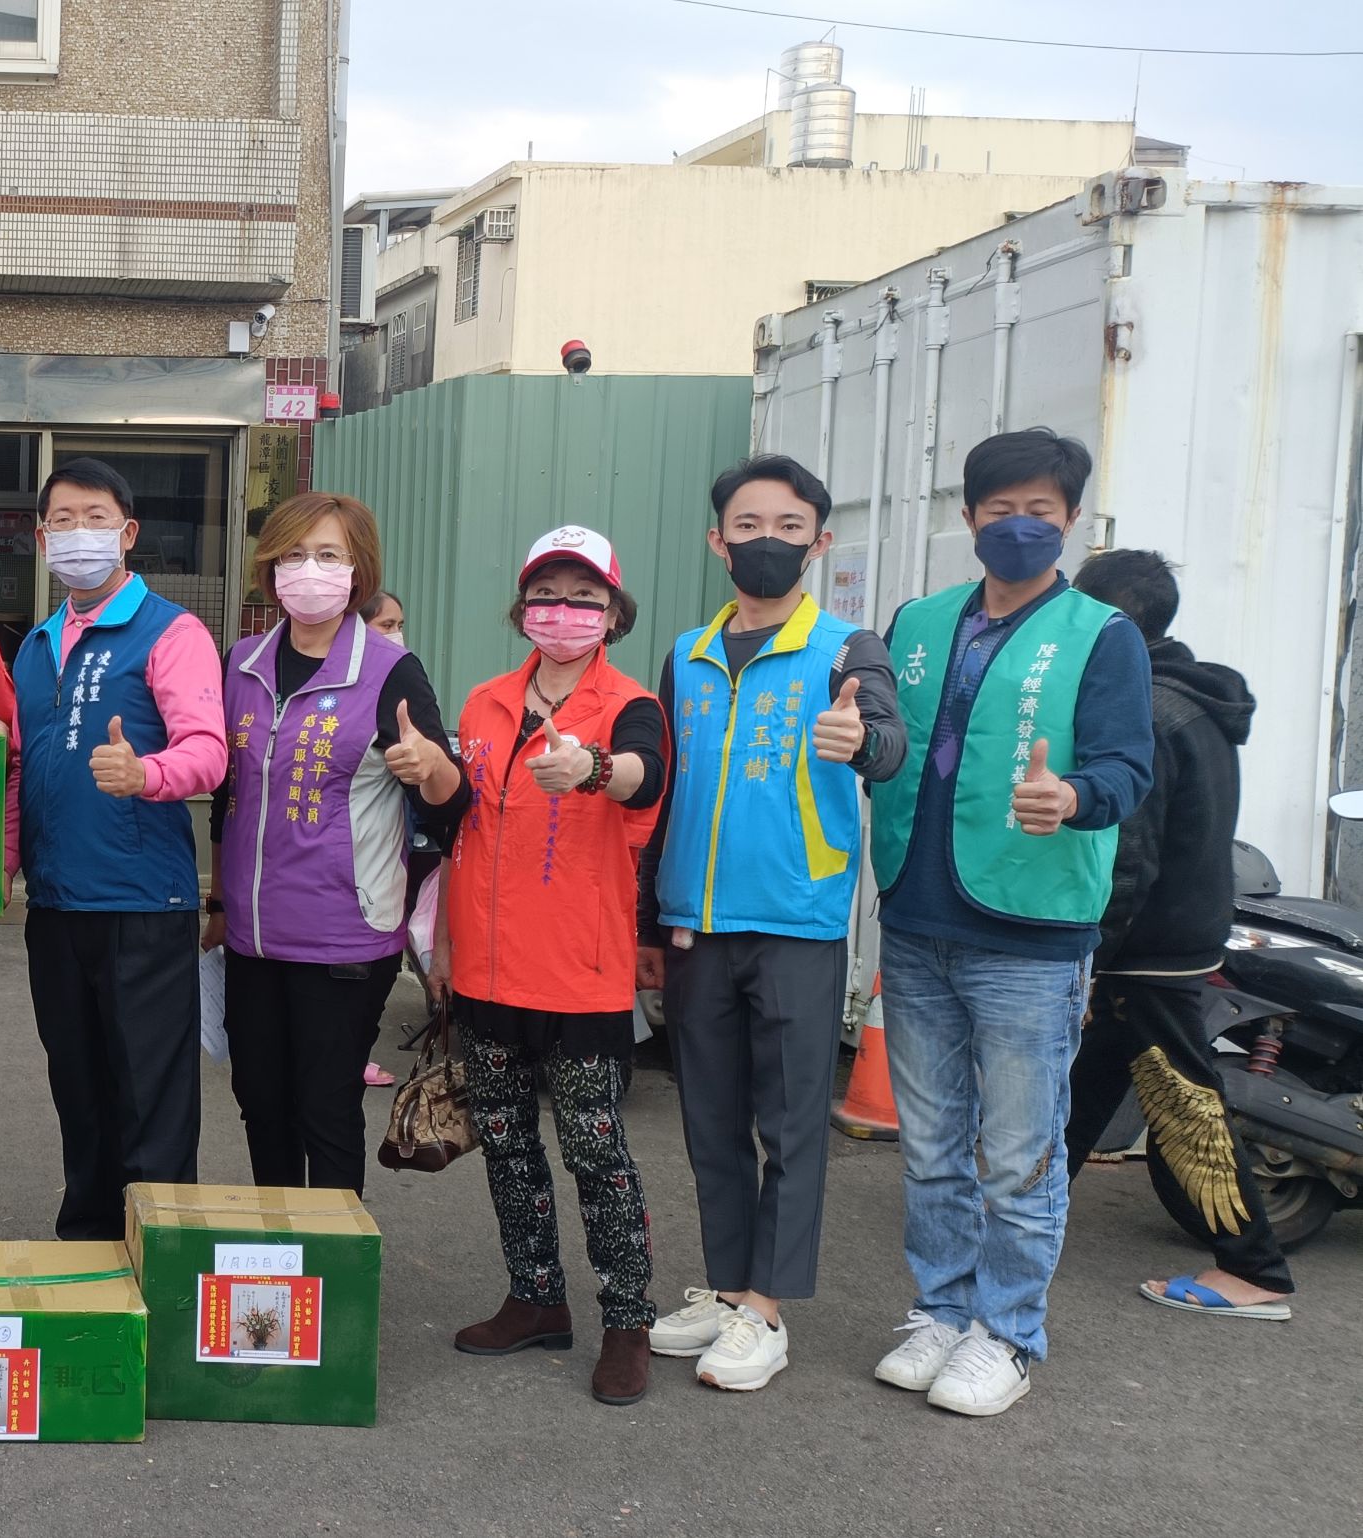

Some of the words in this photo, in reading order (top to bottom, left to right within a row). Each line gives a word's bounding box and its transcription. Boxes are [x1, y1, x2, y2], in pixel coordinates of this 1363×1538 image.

[281, 400, 306, 417] 42
[259, 433, 272, 474] 龍潭區
[276, 434, 288, 472] 桃園市
[89, 650, 112, 702] 凌雲里
[898, 643, 927, 686] 志
[236, 713, 254, 748] 助理
[780, 680, 804, 768] 桃園市議員
[286, 713, 318, 821] 感恩服務團隊
[221, 1255, 272, 1269] 1月13日
[209, 1285, 218, 1347] 隆祥經濟發展基金會
